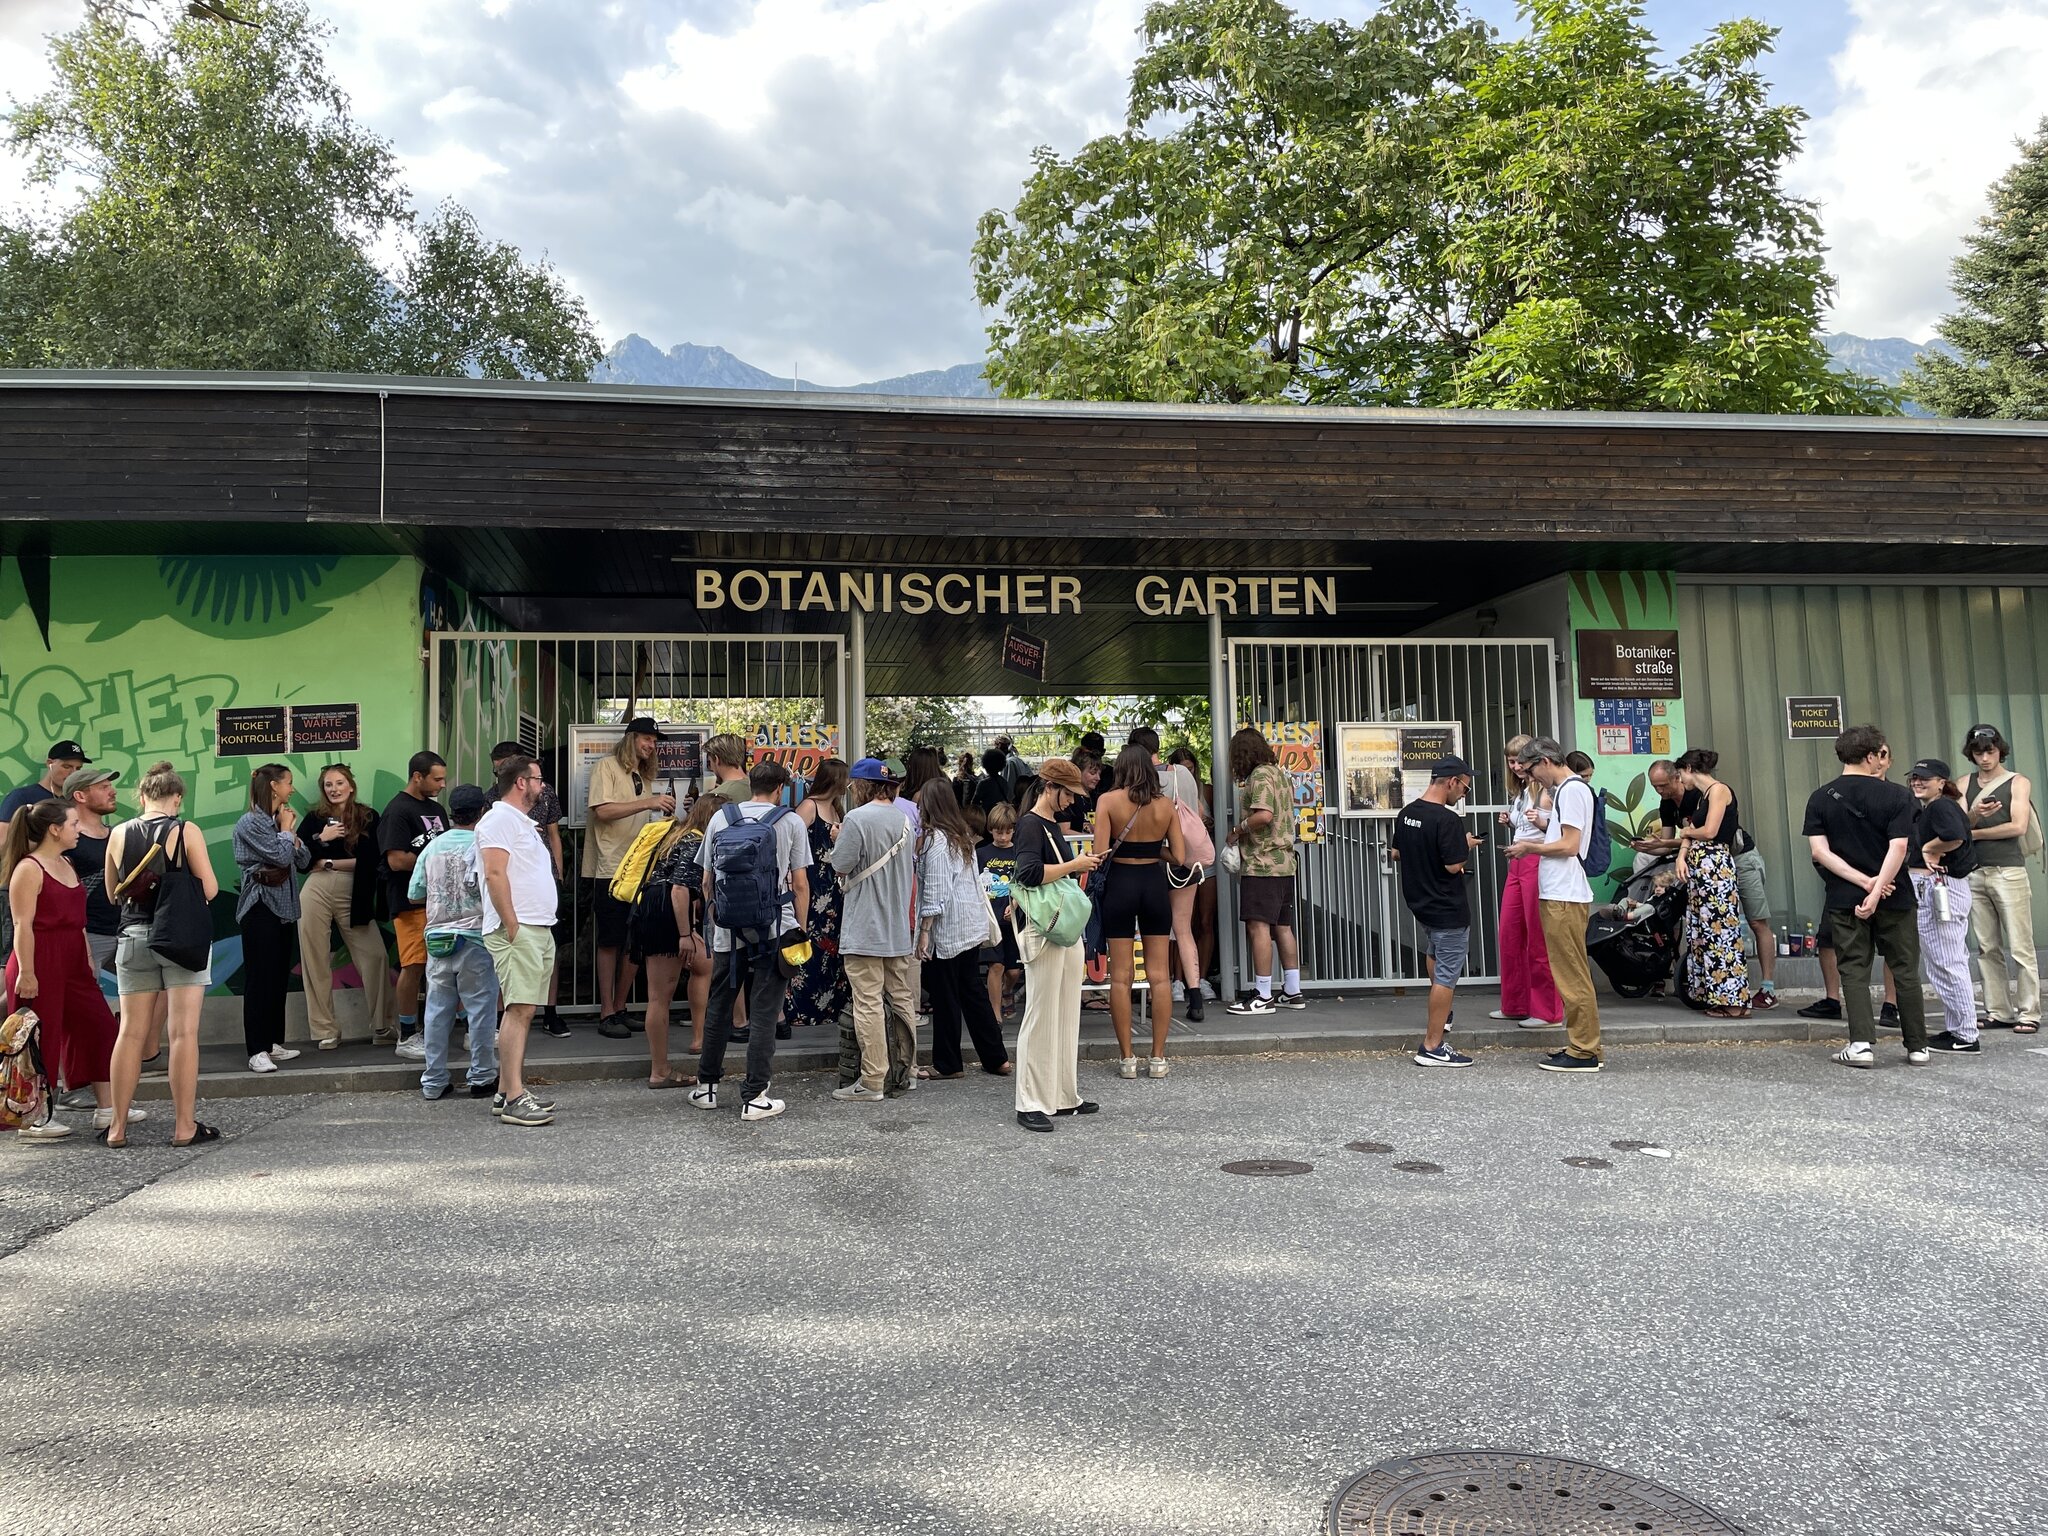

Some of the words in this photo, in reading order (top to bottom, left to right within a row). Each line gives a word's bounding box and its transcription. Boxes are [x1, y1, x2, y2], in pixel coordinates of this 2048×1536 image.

[696, 569, 1082, 615] BOTANISCHER
[1135, 575, 1337, 616] GARTEN
[1008, 640, 1041, 659] AUSVER-
[1616, 645, 1676, 659] Botaniker-
[1011, 653, 1036, 670] KAUFT
[1635, 661, 1673, 674] straße
[1801, 709, 1828, 717] TICKET
[233, 721, 270, 731] TICKET
[303, 718, 346, 728] WARTE-
[1793, 720, 1838, 728] KONTROLLE
[221, 733, 283, 745] KONTROLLE
[294, 731, 355, 742] SCHLANGE
[658, 759, 698, 768] HLANGE
[1404, 816, 1422, 828] team
